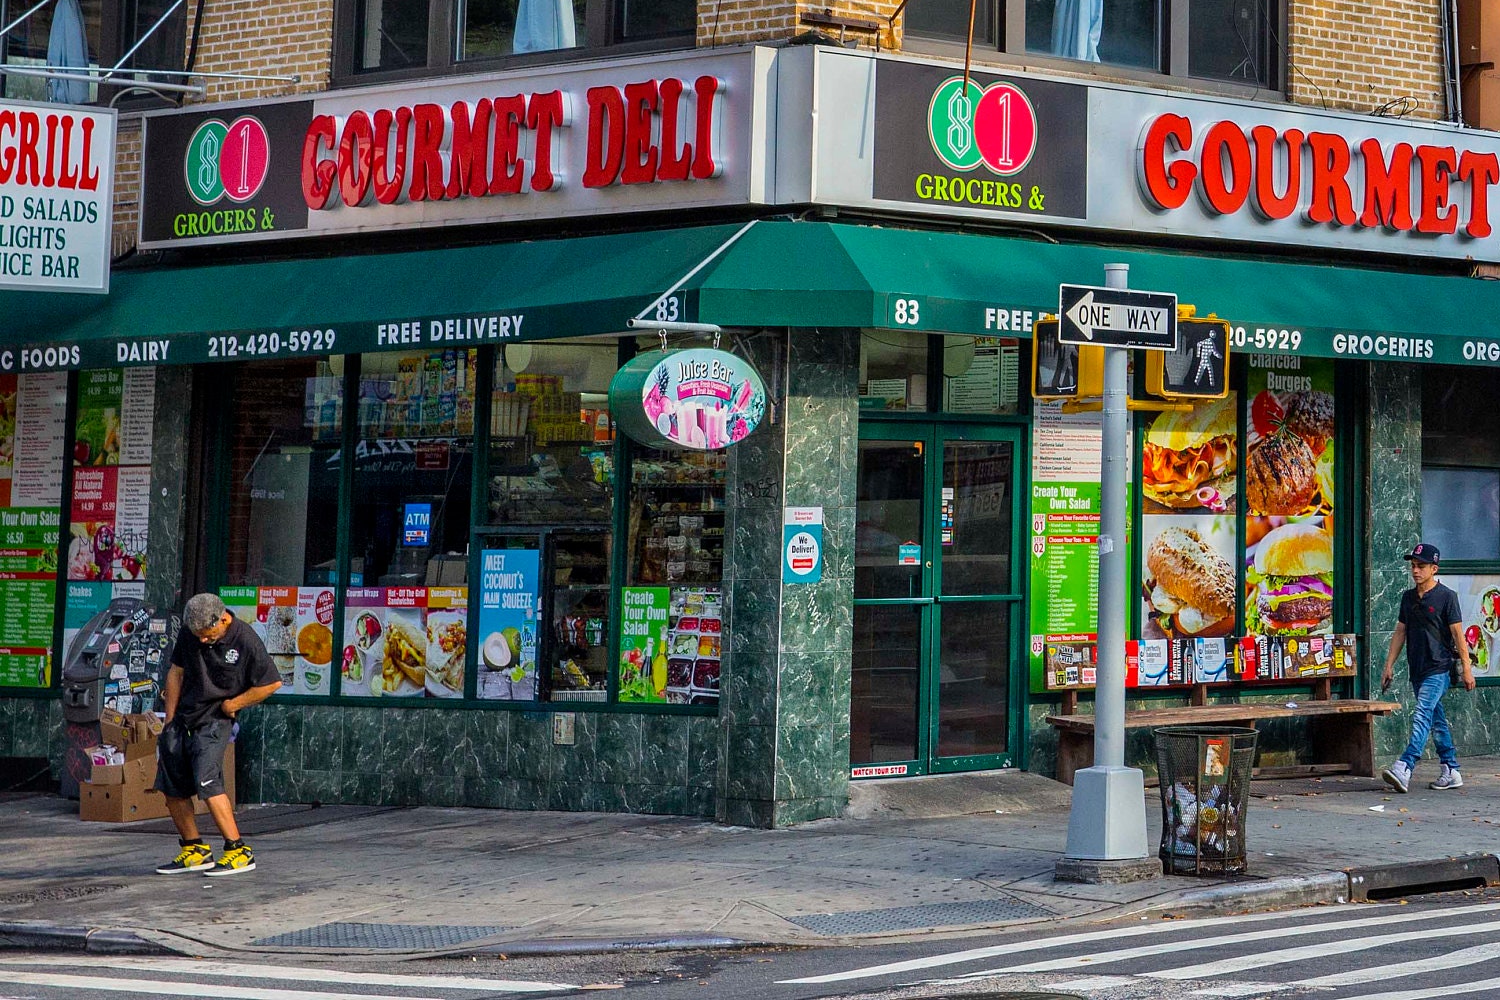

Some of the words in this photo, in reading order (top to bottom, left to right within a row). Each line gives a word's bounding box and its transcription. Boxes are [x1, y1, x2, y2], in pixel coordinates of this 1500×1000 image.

[0, 109, 99, 192] GRILL
[302, 88, 567, 211] GOURMET
[582, 75, 723, 189] DELI
[1142, 112, 1500, 240] GOURMET
[915, 173, 1025, 208] GROCERS
[1029, 185, 1044, 210] &
[23, 196, 98, 224] SALADS
[173, 208, 256, 237] GROCERS
[261, 207, 275, 230] &
[0, 253, 32, 276] ICE
[41, 254, 80, 279] BAR
[655, 296, 679, 322] 83
[894, 299, 920, 324] 83
[984, 308, 1033, 332] FREE
[1078, 304, 1111, 327] ONE
[1127, 308, 1161, 332] WAY
[377, 322, 424, 346] FREE
[430, 314, 523, 342] DELIVERY
[117, 340, 170, 362] DAIRY
[208, 329, 337, 358] 212-420-5929
[1333, 333, 1434, 359] GROCERIES
[21, 345, 80, 368] FOODS
[1249, 354, 1301, 370] Charcoal
[677, 358, 709, 384] Juice
[711, 359, 734, 383] Bar
[1266, 373, 1313, 394] Burgers
[1033, 485, 1058, 498] Create
[1060, 485, 1078, 498] Your
[1049, 497, 1067, 510] Own
[1068, 497, 1091, 510] Salad
[1, 511, 19, 526] Your
[21, 512, 38, 526] Own
[405, 513, 430, 526] ATM
[1034, 520, 1044, 531] 01
[6, 531, 24, 545] $6.50
[798, 536, 808, 545] We
[791, 544, 815, 554] Deliver!
[1033, 543, 1044, 554] 02
[484, 554, 505, 571] MEET
[483, 571, 524, 590] COCONUT'S
[69, 586, 93, 598] Shakes
[220, 588, 237, 598] Served
[246, 589, 255, 598] Day
[363, 589, 379, 598] Wraps
[406, 589, 414, 597] The
[415, 589, 426, 598] Grill
[483, 592, 500, 606] MAIN
[501, 593, 533, 609] SQUEEZE
[624, 590, 654, 605] Create
[623, 605, 644, 621] Your
[646, 606, 667, 620] Own
[623, 621, 649, 636] Salad
[1032, 642, 1043, 653] 03
[853, 769, 873, 777] WATCH
[874, 768, 889, 776] YOUR
[890, 766, 906, 774] STEP
